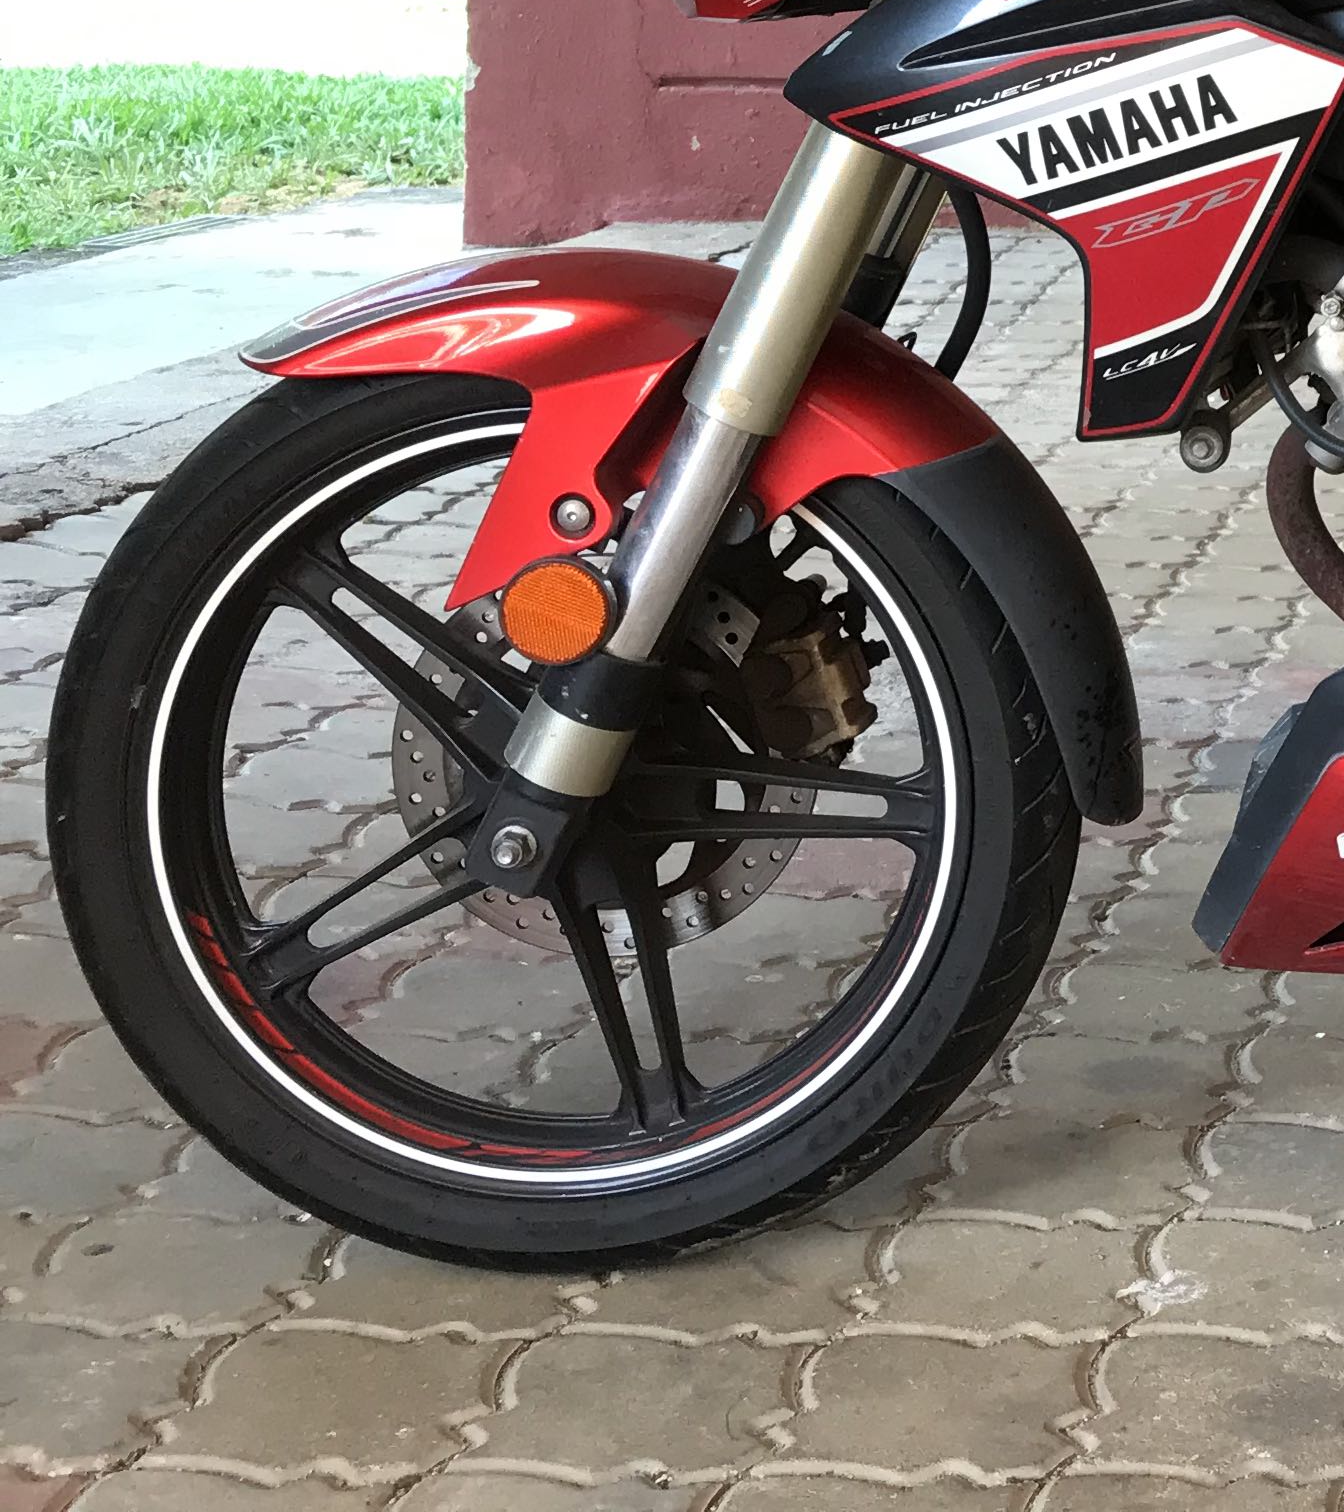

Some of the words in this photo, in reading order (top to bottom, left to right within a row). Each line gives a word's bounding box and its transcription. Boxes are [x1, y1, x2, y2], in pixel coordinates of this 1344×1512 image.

[875, 111, 947, 135] FUEL
[954, 52, 1117, 115] INJECTION
[996, 74, 1239, 186] YAMAHA
